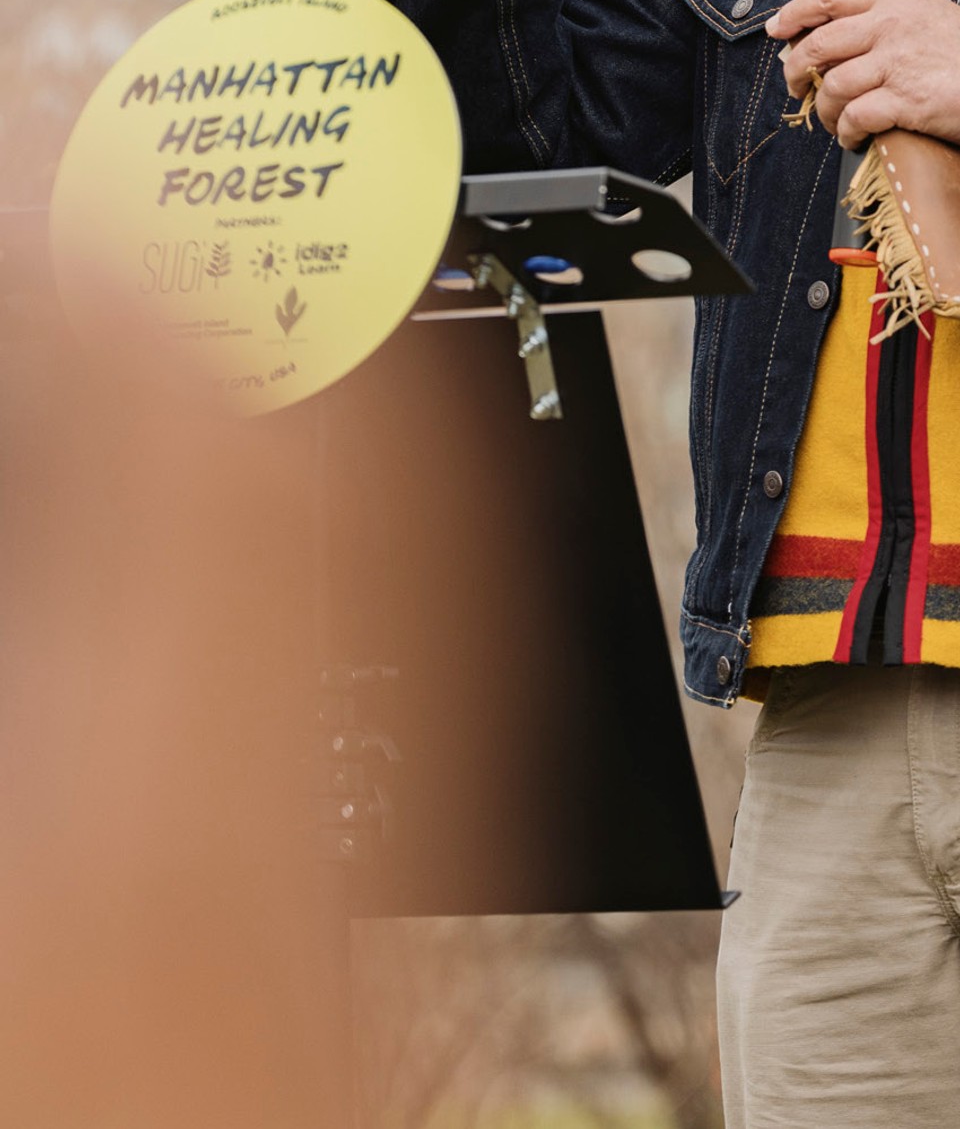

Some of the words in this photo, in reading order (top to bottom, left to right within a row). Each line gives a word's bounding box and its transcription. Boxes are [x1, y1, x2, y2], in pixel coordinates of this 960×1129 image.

[119, 53, 401, 109] MANHATTAN
[157, 105, 352, 155] HEALING
[157, 162, 345, 207] FOREST
